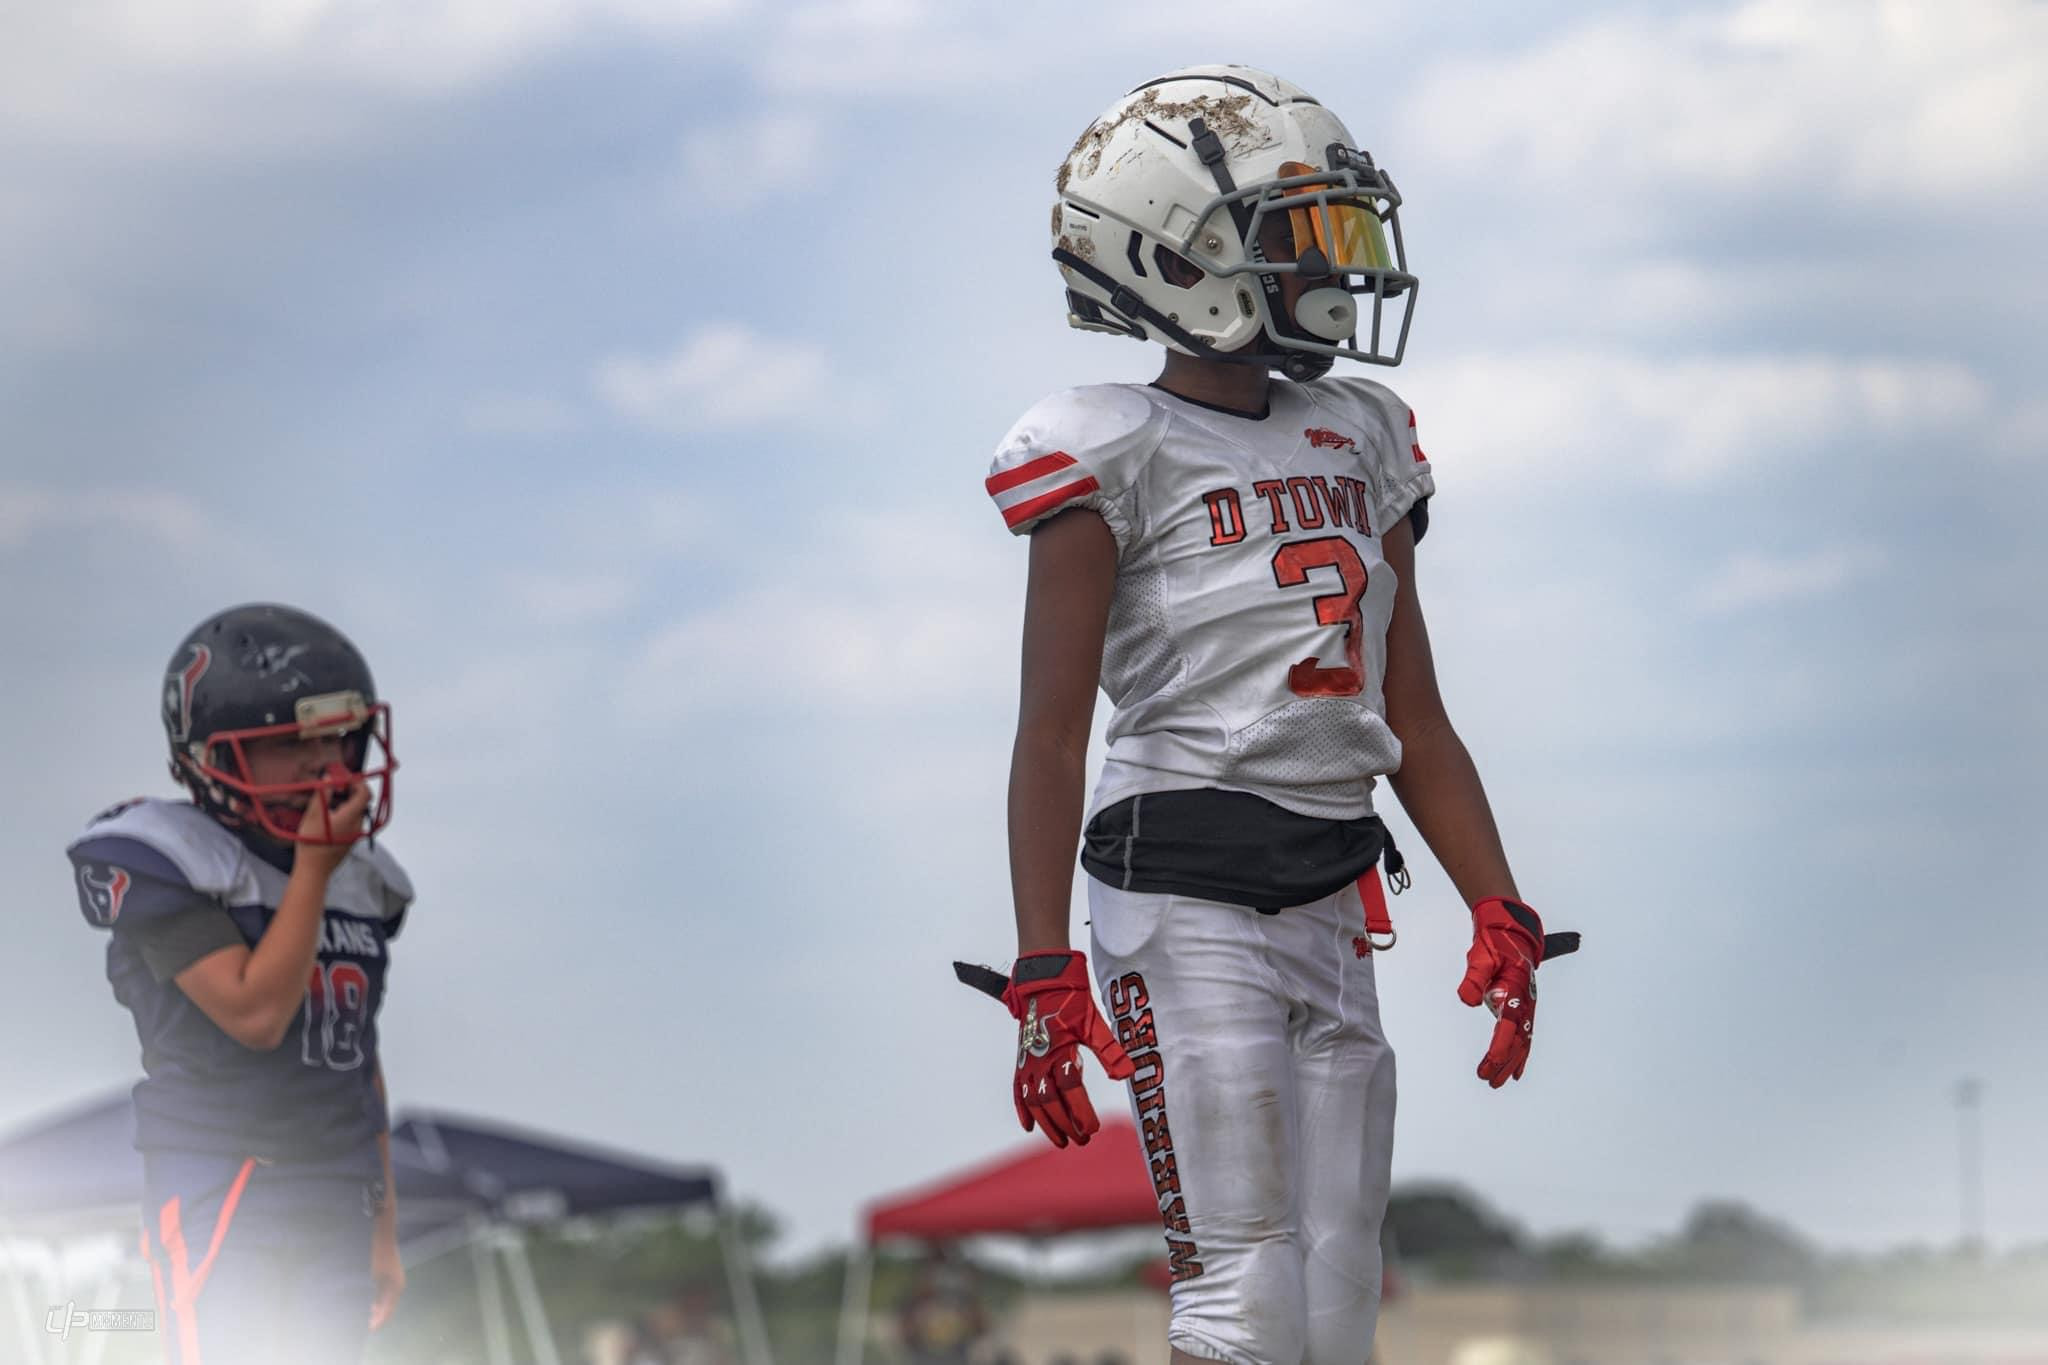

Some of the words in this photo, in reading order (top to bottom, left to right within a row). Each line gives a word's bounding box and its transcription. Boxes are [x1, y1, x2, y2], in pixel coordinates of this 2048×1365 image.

[1202, 487, 1247, 547] D
[1253, 475, 1372, 537] TOWN
[1272, 535, 1369, 697] 3
[1110, 971, 1205, 1284] WARRIORS
